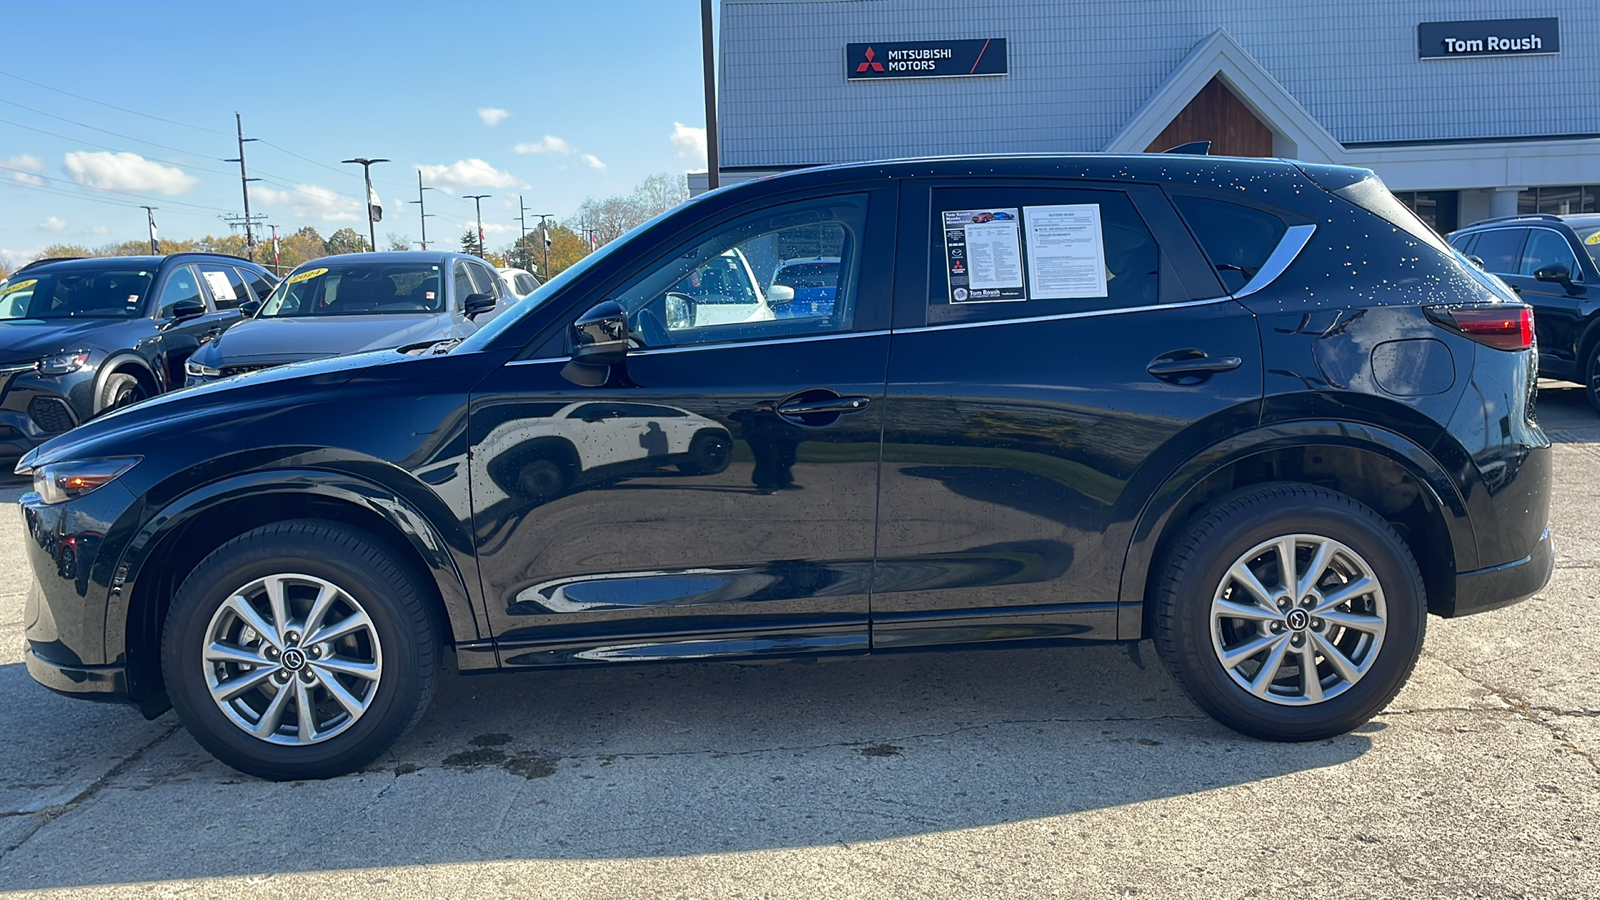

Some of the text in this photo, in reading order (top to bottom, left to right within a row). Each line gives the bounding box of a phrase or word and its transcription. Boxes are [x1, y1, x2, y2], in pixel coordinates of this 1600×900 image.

[1445, 34, 1541, 52] Tom Roush
[888, 49, 952, 60] MITSUBISHI
[888, 60, 936, 71] MOTORS
